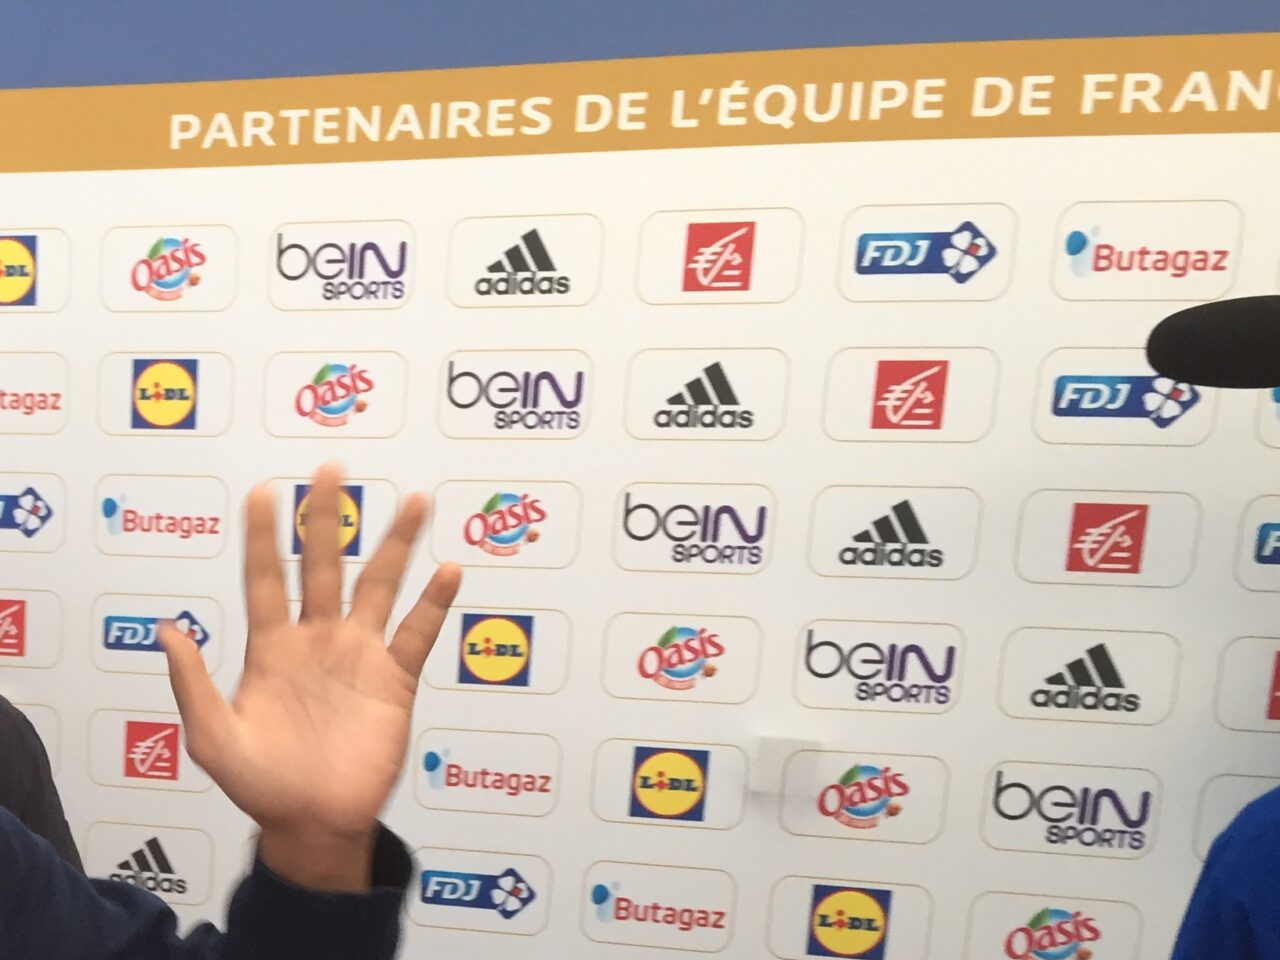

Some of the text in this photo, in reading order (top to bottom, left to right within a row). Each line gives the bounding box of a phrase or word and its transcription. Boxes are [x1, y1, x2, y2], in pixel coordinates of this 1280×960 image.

[170, 69, 1280, 150] PARTENAIRES DE L'ÉQUIPE DE FRAN
[130, 237, 207, 293] Oasis
[860, 239, 930, 267] FDJ
[1092, 243, 1229, 278] Butagaz
[322, 280, 405, 301] SPORTS
[474, 270, 571, 296] adidas
[294, 363, 374, 418] Oasis
[1058, 383, 1130, 410] FDJ
[494, 410, 581, 430] SPORTS
[654, 404, 754, 429] adidas
[122, 510, 220, 541] Butagaz
[463, 492, 548, 545] Oasis
[671, 544, 762, 566] SPORTS
[838, 542, 944, 568] adidas
[106, 620, 159, 646] FDJ
[636, 627, 726, 680] Oasis
[855, 682, 951, 705] SPORTS
[1029, 685, 1140, 713] adidas
[445, 762, 552, 797] Butagaz
[816, 766, 910, 818] Oasis
[1045, 824, 1146, 851] SPORTS
[424, 875, 481, 902] FDJ
[613, 897, 727, 932] Butagaz
